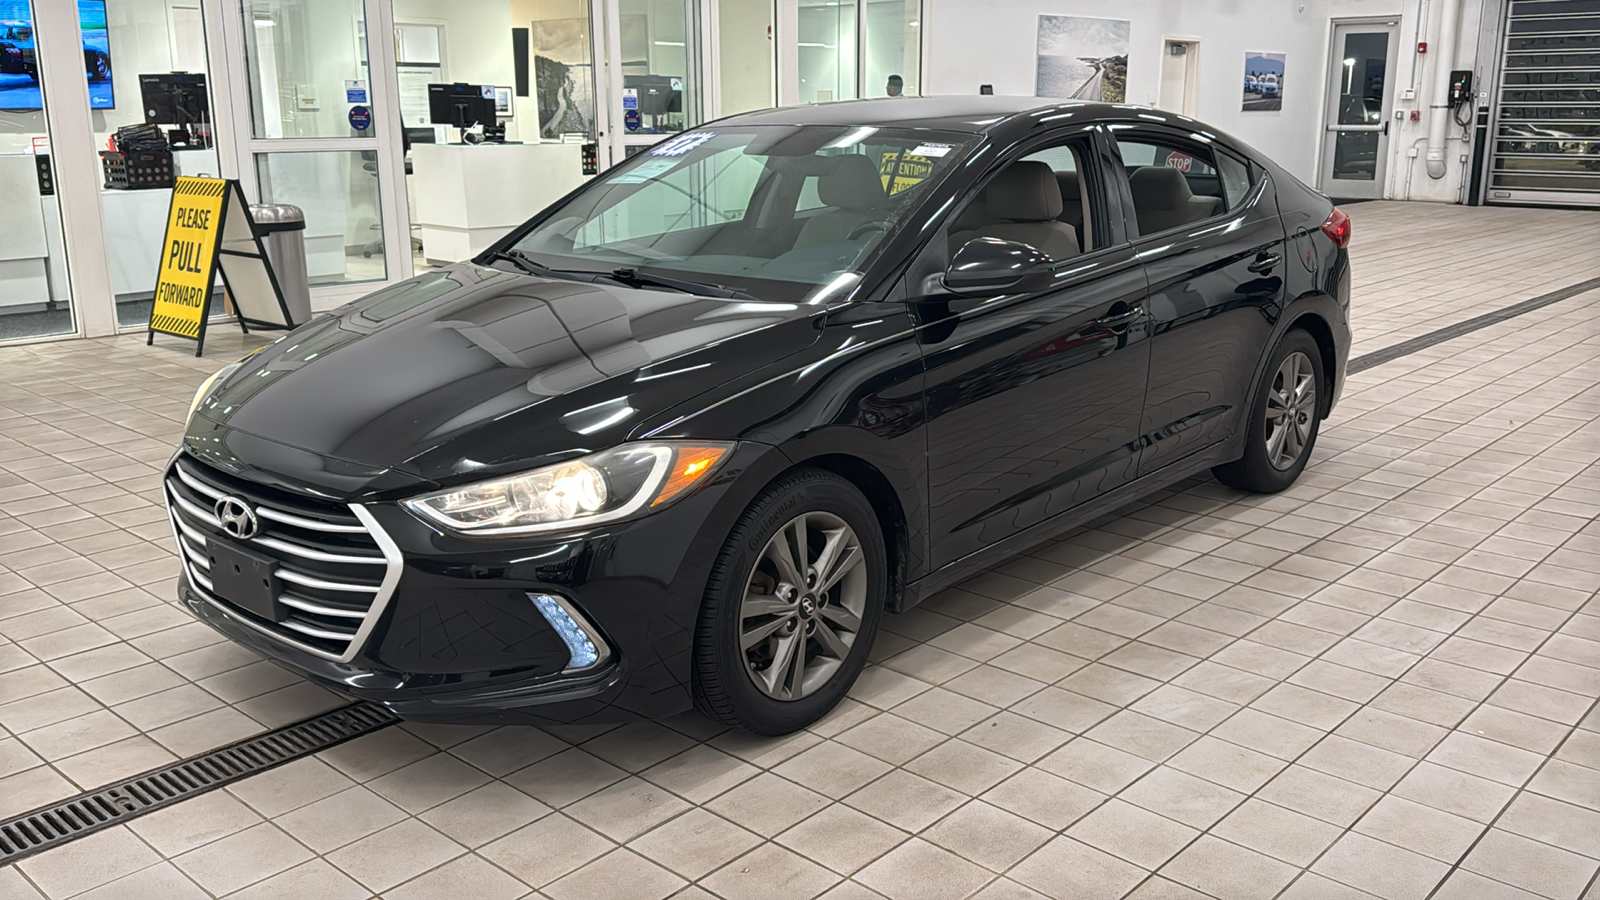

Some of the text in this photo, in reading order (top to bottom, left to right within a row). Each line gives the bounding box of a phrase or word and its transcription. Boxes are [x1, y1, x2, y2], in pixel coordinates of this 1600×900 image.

[885, 162, 927, 176] ATENTION
[1168, 157, 1190, 169] STOP
[175, 207, 212, 230] PLEASE
[168, 239, 202, 274] PULL
[157, 281, 203, 309] FORWARD
[749, 495, 797, 552] Continental
